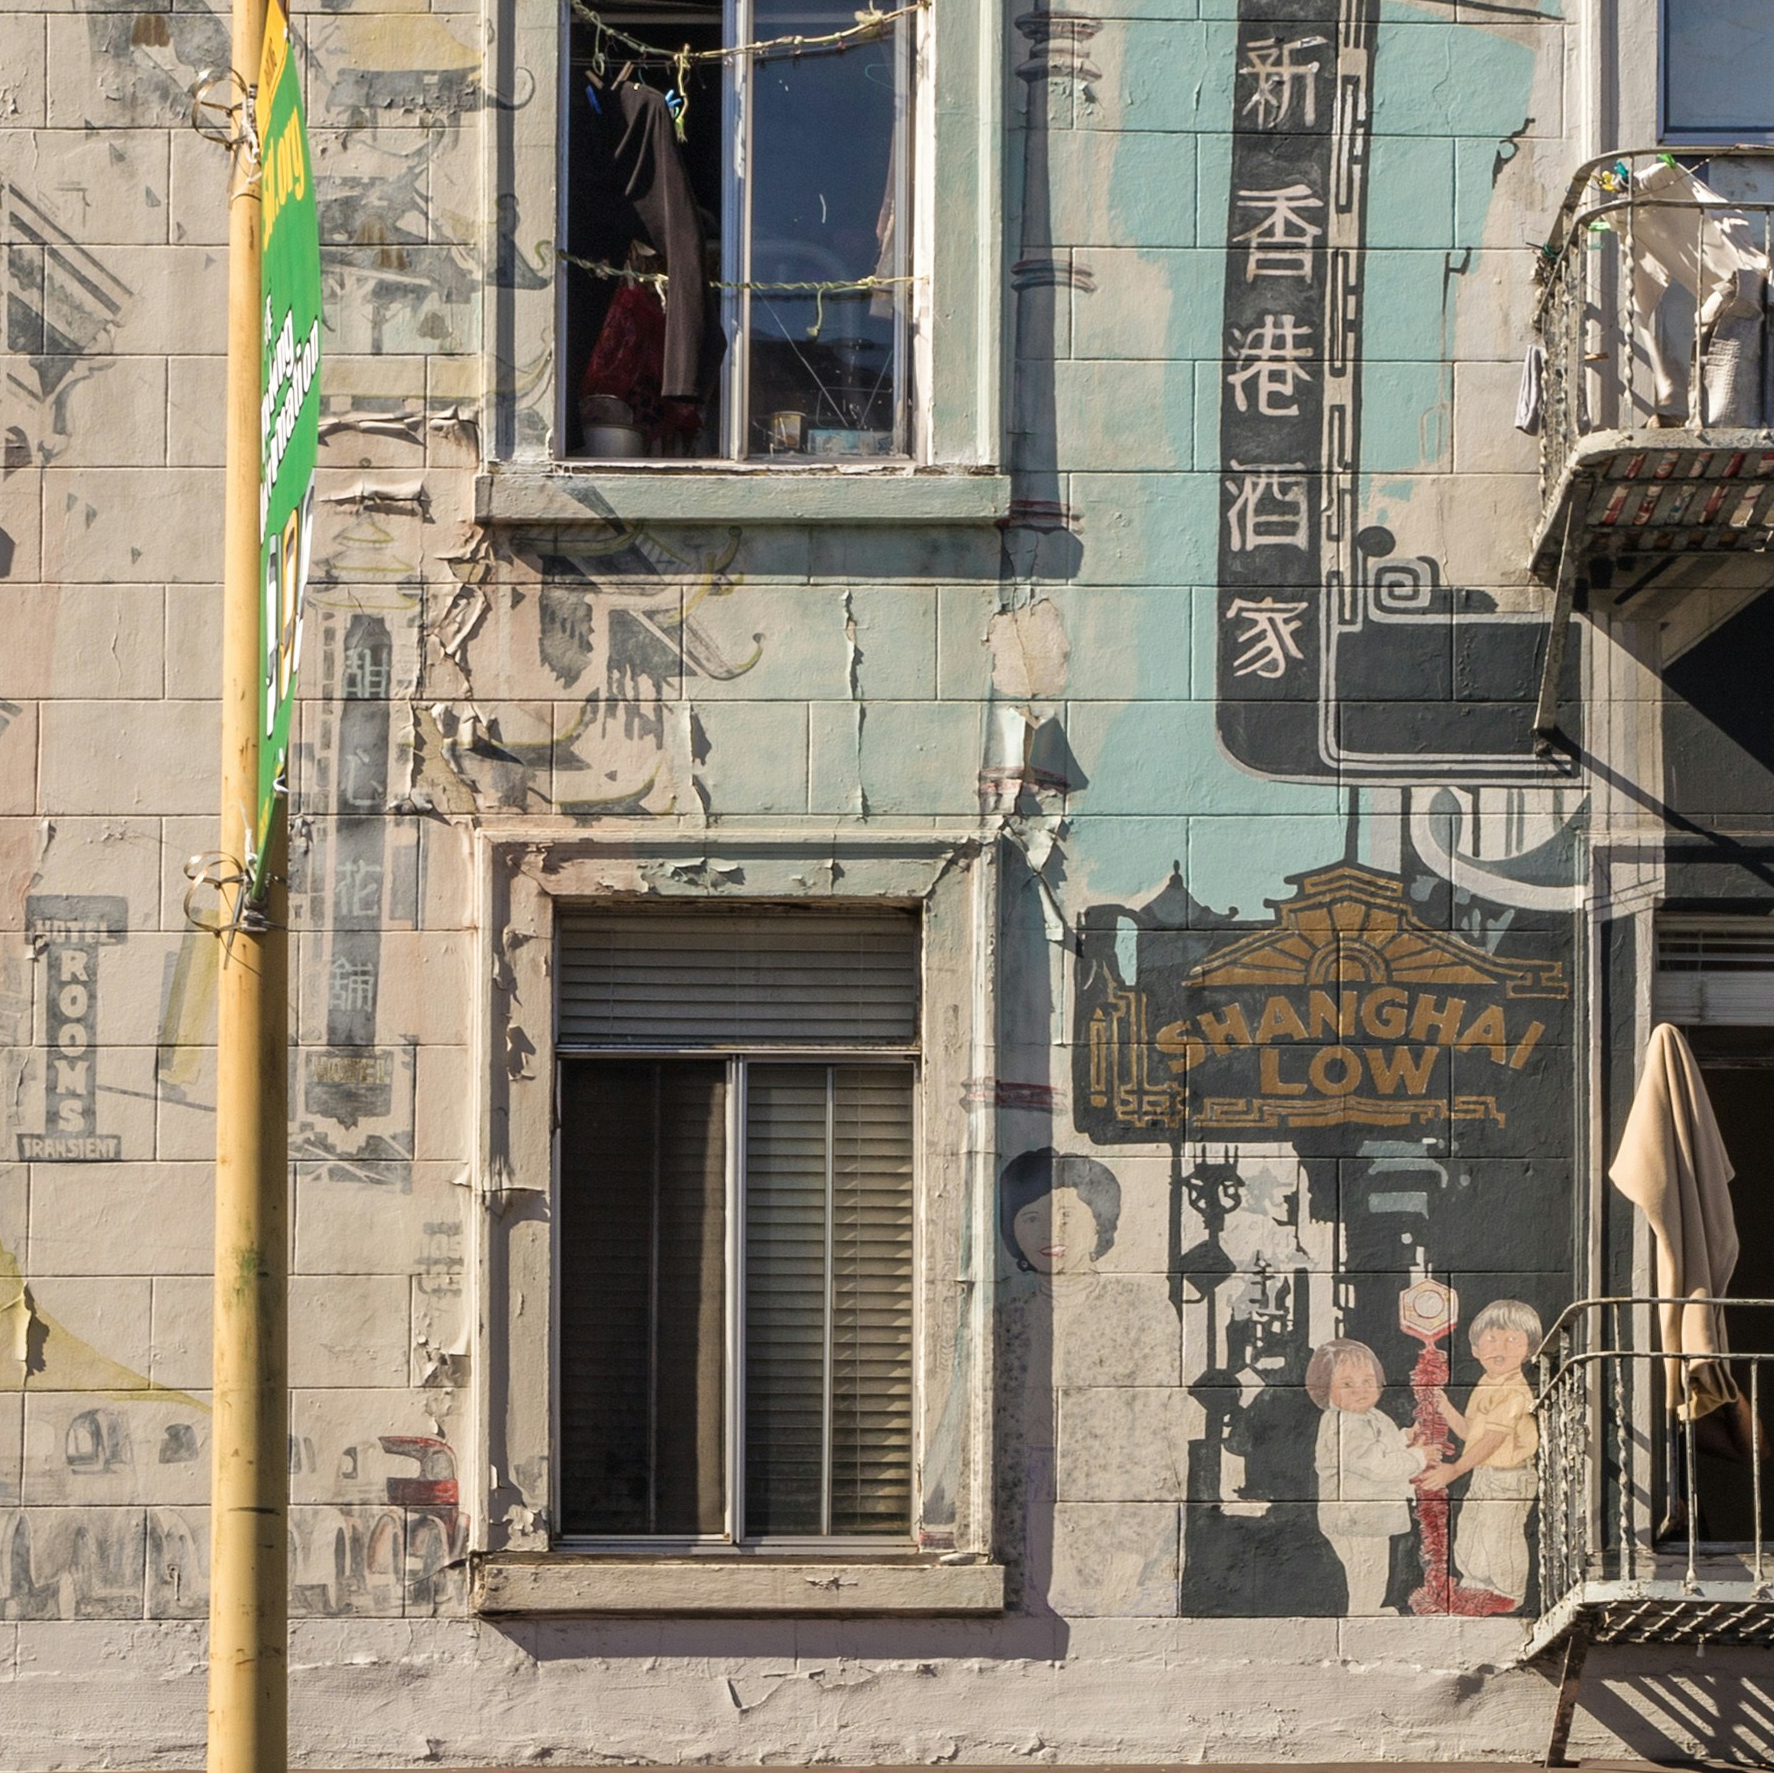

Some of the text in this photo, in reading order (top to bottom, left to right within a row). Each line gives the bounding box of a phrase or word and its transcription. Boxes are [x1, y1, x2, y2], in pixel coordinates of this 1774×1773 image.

[1226, 35, 1326, 680] 新香港酒家
[33, 919, 117, 944] HOTEL
[53, 948, 91, 1132] ROOMS
[1156, 986, 1545, 1074] SHANGHAI
[1260, 1045, 1440, 1096] LOW
[22, 1136, 118, 1160] TRANSIENT
